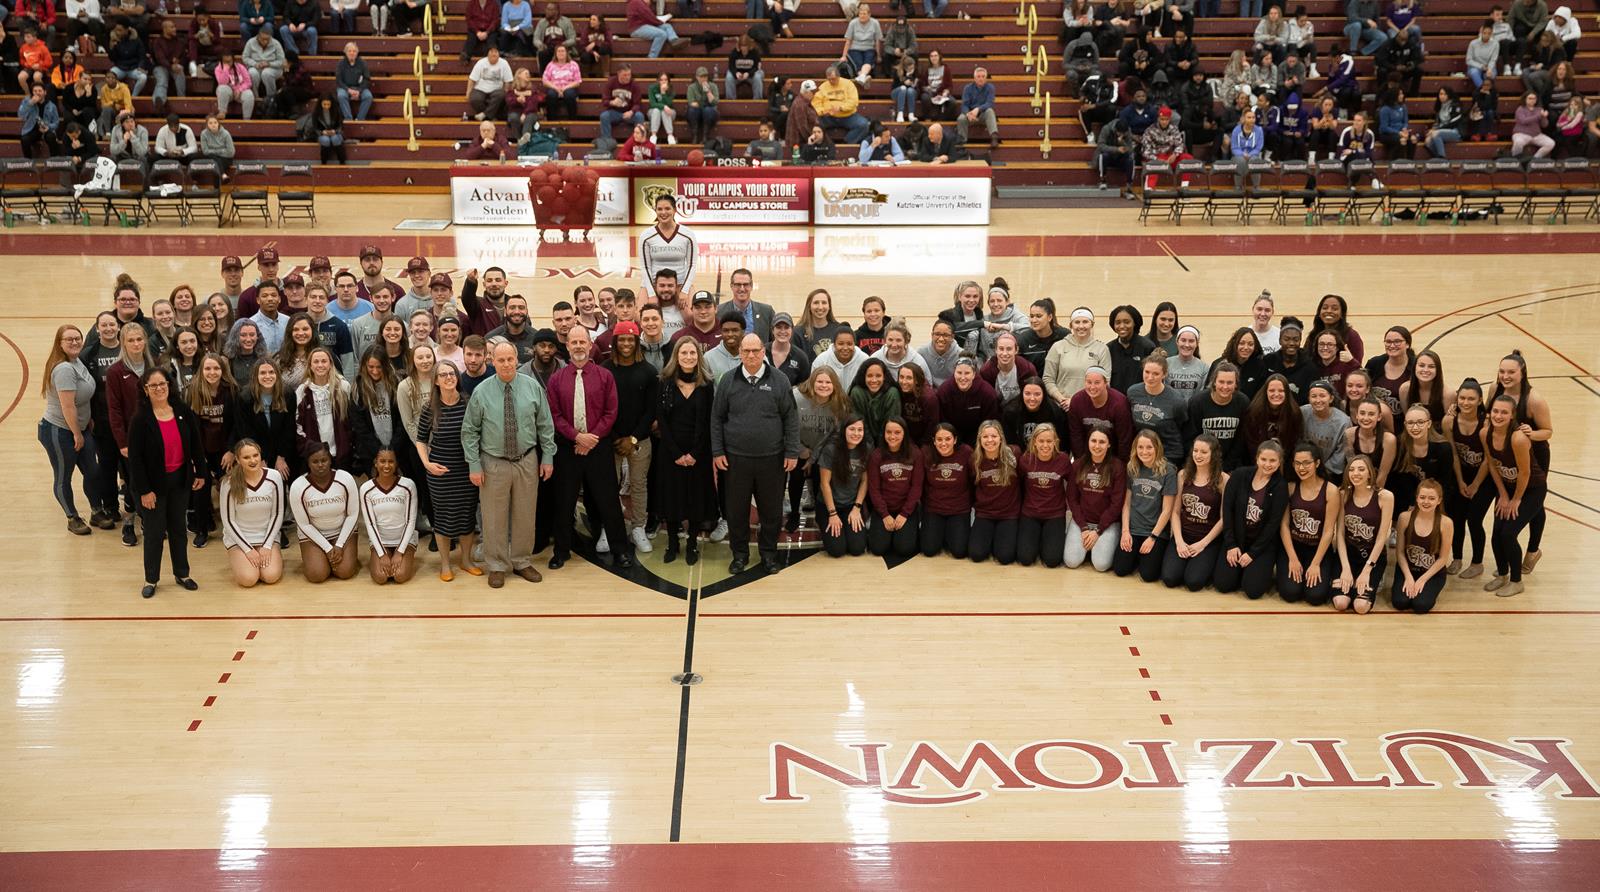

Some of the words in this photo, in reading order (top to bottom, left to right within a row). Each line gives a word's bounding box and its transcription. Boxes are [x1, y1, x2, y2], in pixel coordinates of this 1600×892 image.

[717, 158, 749, 167] POSS.
[683, 184, 705, 196] YOUR
[708, 184, 744, 197] CAMPUS,
[746, 184, 768, 196] YOUR
[771, 184, 797, 196] STORE
[709, 202, 721, 210] KU
[723, 202, 758, 210] CAMPUS
[760, 202, 788, 210] STORE
[926, 202, 955, 210] University
[1202, 417, 1239, 429] KUTZTOWN
[764, 730, 1600, 805] KUTZTOWN
